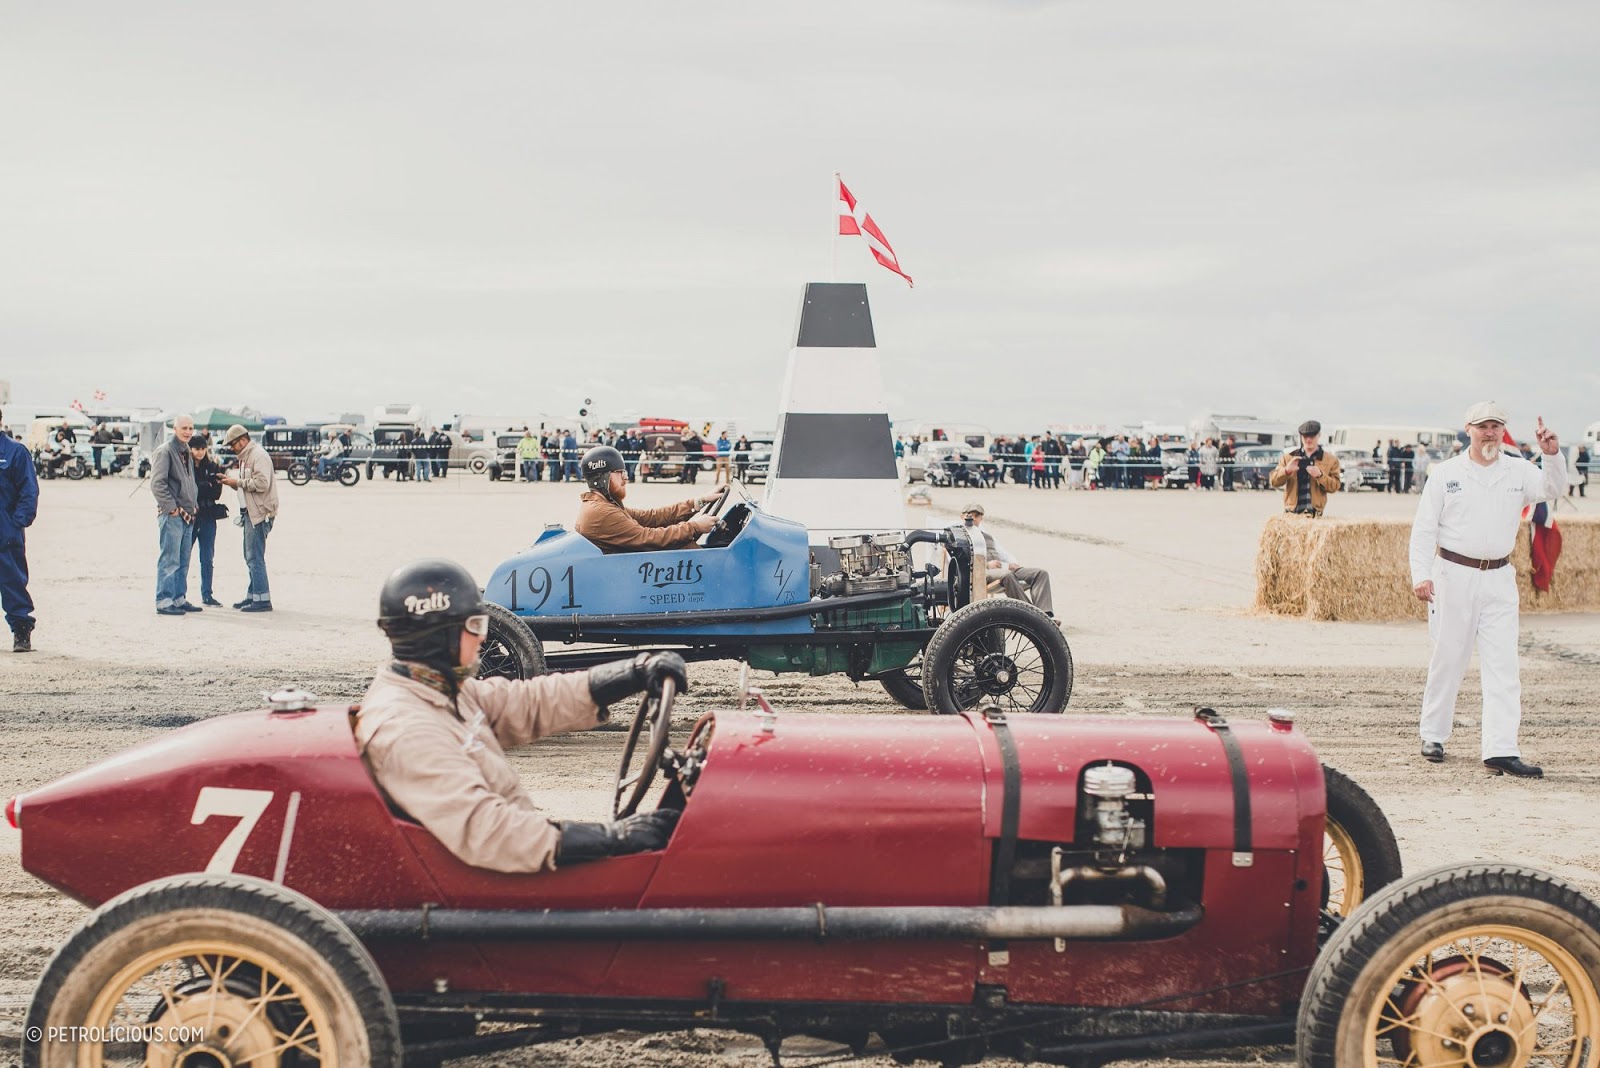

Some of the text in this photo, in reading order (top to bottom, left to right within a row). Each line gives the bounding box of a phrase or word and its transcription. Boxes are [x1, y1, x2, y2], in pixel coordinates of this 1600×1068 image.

[504, 565, 583, 611] 191
[638, 559, 703, 588] Pratts
[649, 593, 686, 605] SPEED
